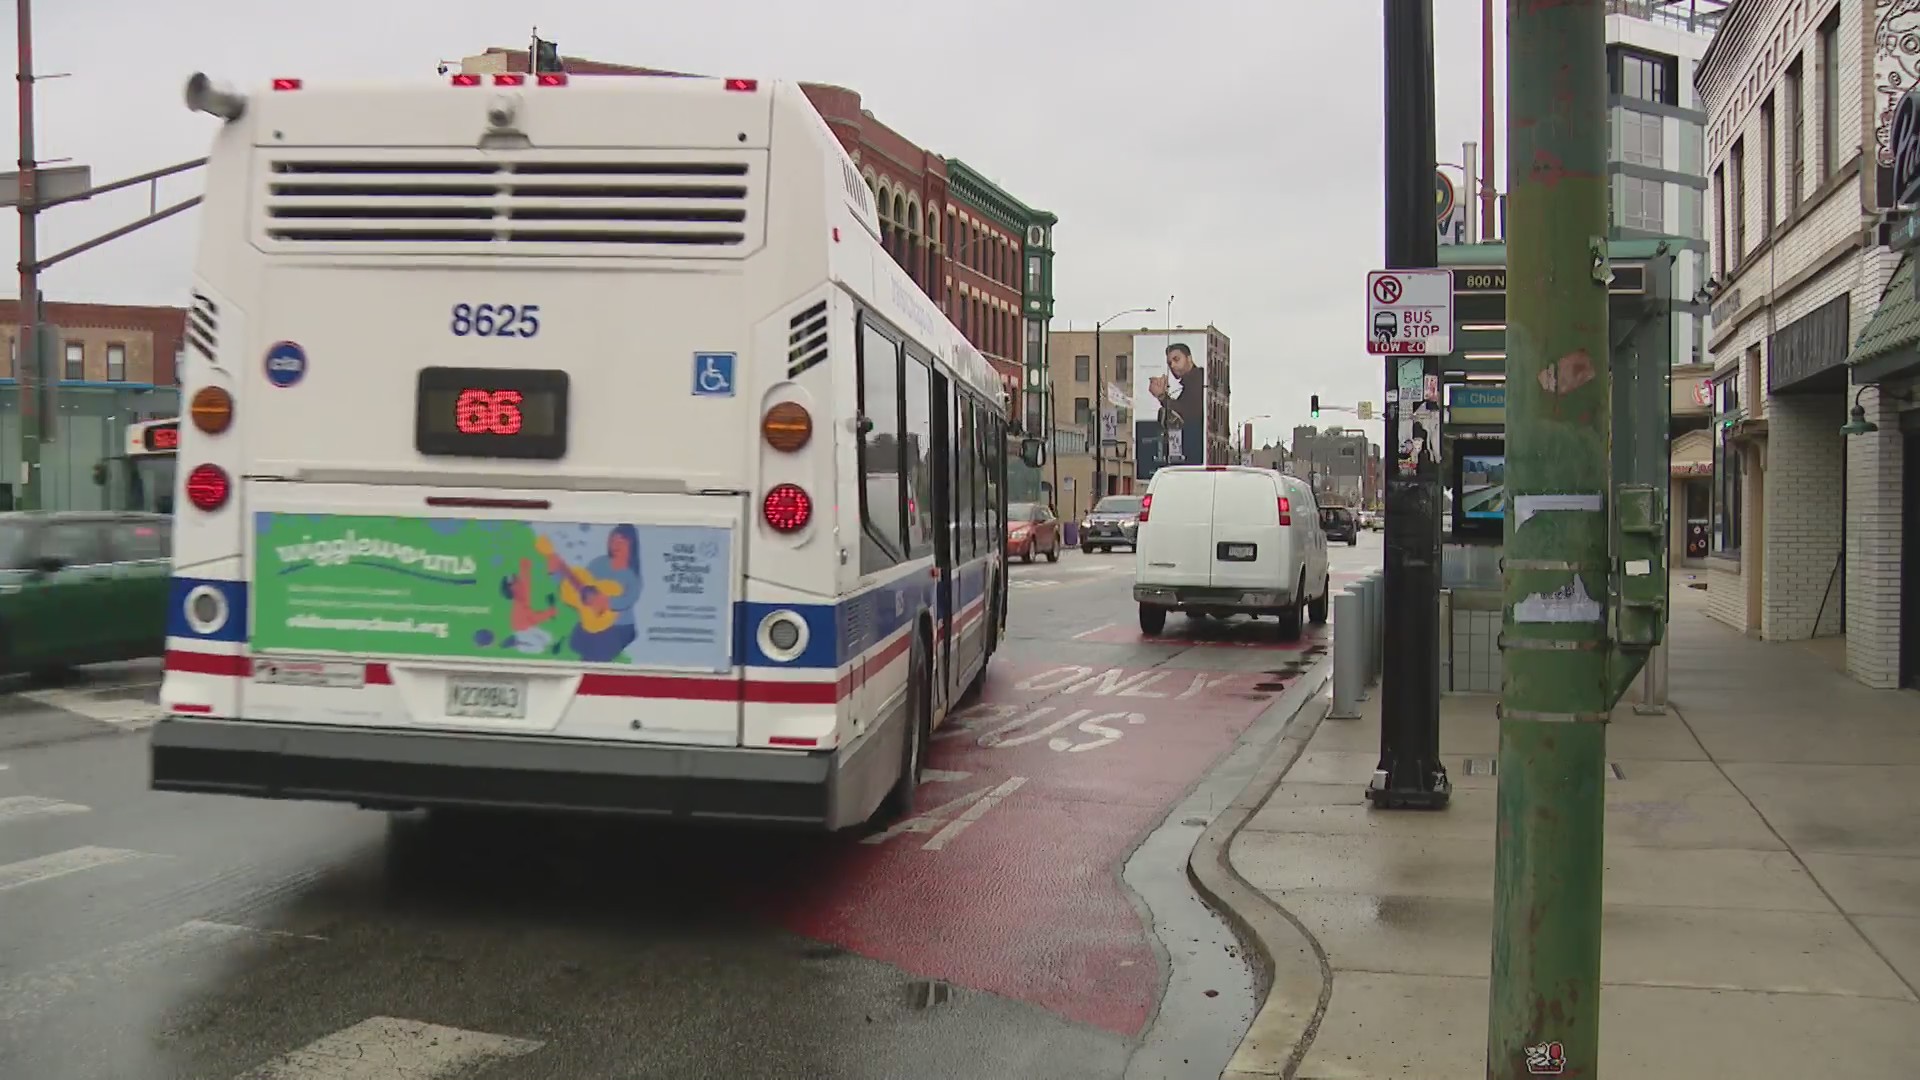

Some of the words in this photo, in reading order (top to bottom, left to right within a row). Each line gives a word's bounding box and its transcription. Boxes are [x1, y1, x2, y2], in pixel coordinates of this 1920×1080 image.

[1467, 275, 1491, 288] 800
[1494, 275, 1505, 288] N
[452, 303, 540, 338] 8625
[1403, 309, 1433, 324] BUS
[1403, 325, 1440, 338] STOP
[1374, 341, 1401, 352] TOW
[1470, 393, 1505, 405] Chica
[456, 388, 523, 434] 66
[275, 529, 477, 574] wiggleworms
[1014, 664, 1237, 700] ONLY
